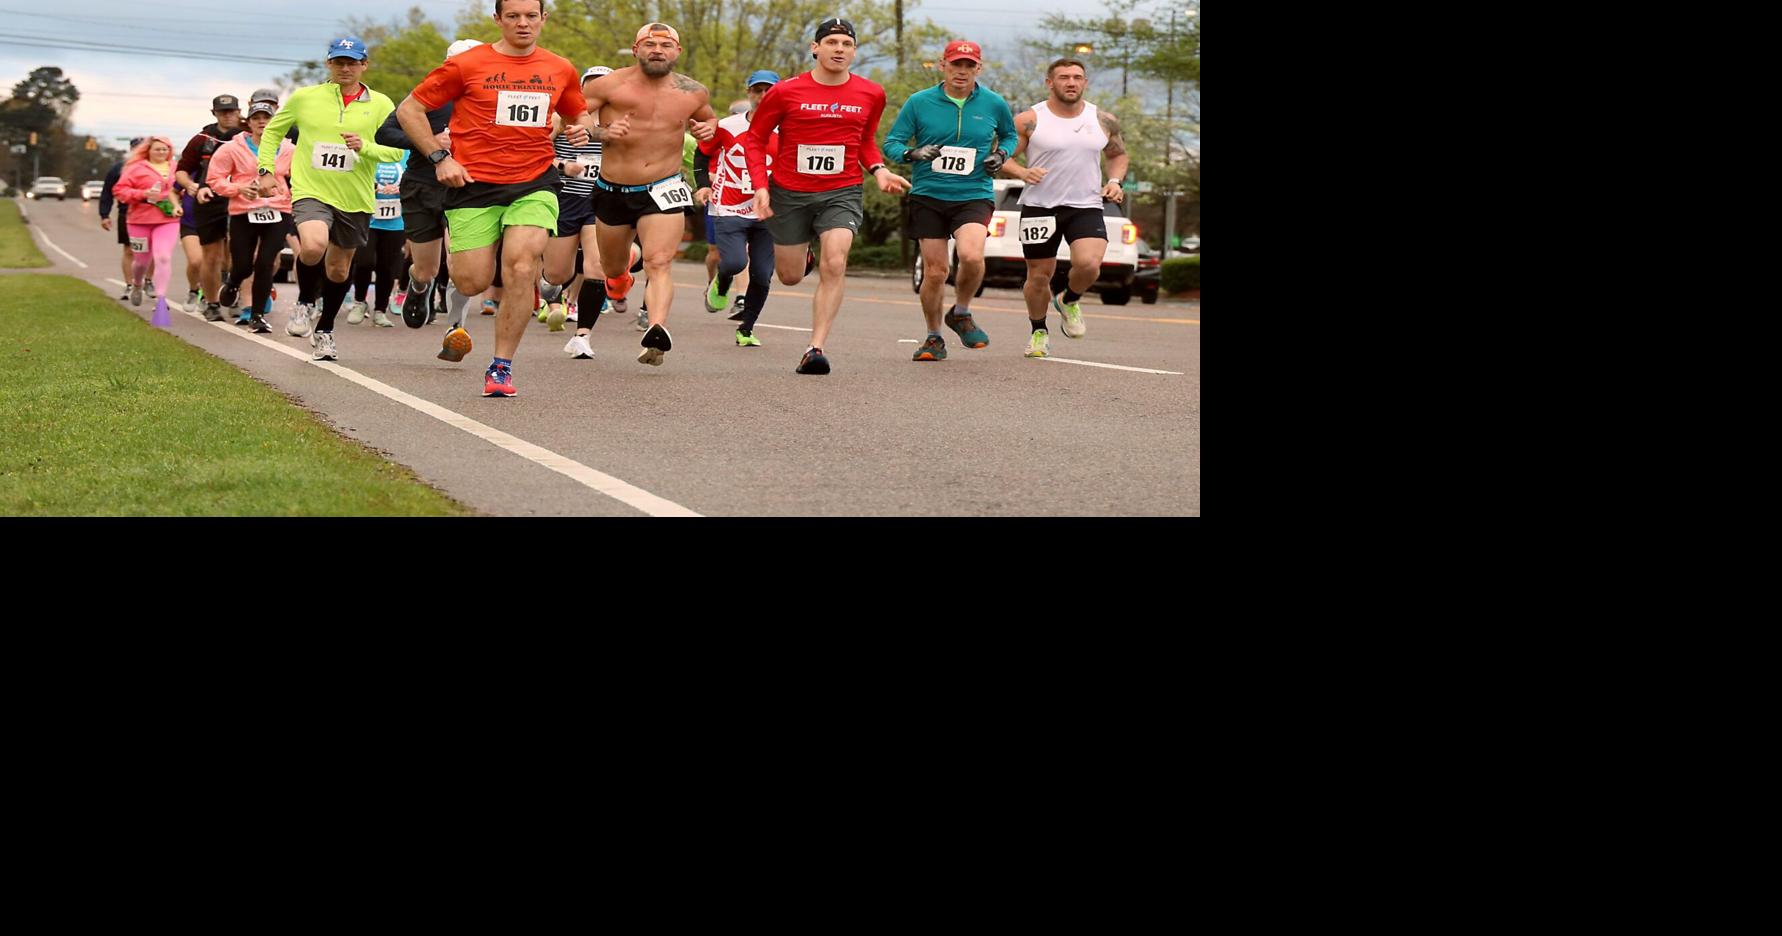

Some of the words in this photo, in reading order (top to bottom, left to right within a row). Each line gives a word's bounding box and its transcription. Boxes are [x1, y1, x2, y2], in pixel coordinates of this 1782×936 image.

[508, 104, 539, 122] 161
[801, 103, 828, 111] FLEET
[840, 105, 862, 113] FEET
[321, 153, 346, 168] 141
[806, 156, 835, 171] 176
[940, 156, 966, 171] 178
[660, 187, 689, 204] 169
[379, 206, 395, 216] 171
[1022, 226, 1049, 241] 182
